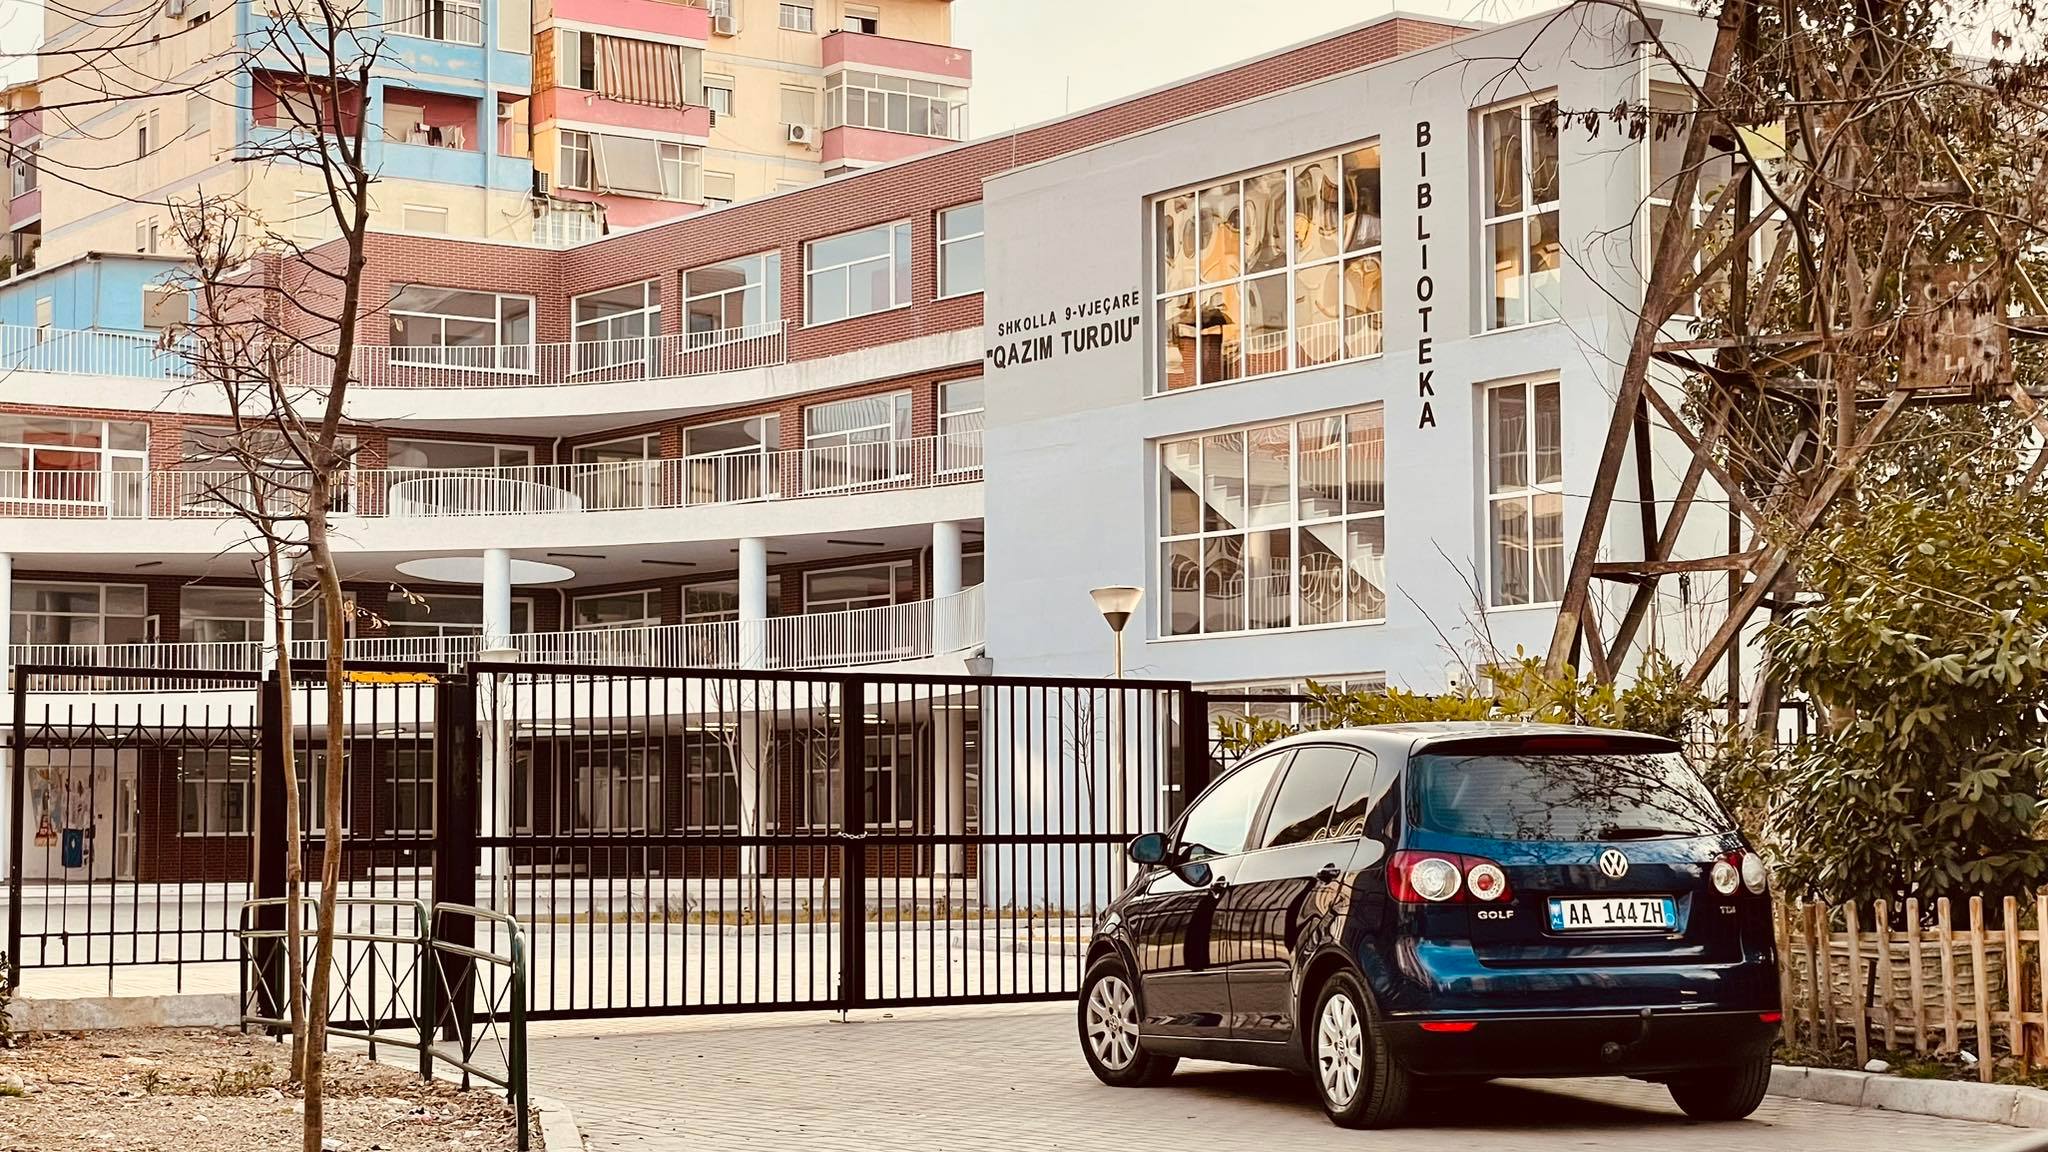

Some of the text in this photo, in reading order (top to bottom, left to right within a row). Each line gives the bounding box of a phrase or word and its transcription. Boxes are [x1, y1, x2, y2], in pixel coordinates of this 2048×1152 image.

[1416, 121, 1436, 429] BIBLIOTEKA
[998, 291, 1140, 337] SHKOLLA 9-VJEÇARE
[986, 316, 1140, 369] "QAZIM TURDIU"
[1477, 910, 1514, 920] GOLF
[1570, 903, 1592, 925] AA
